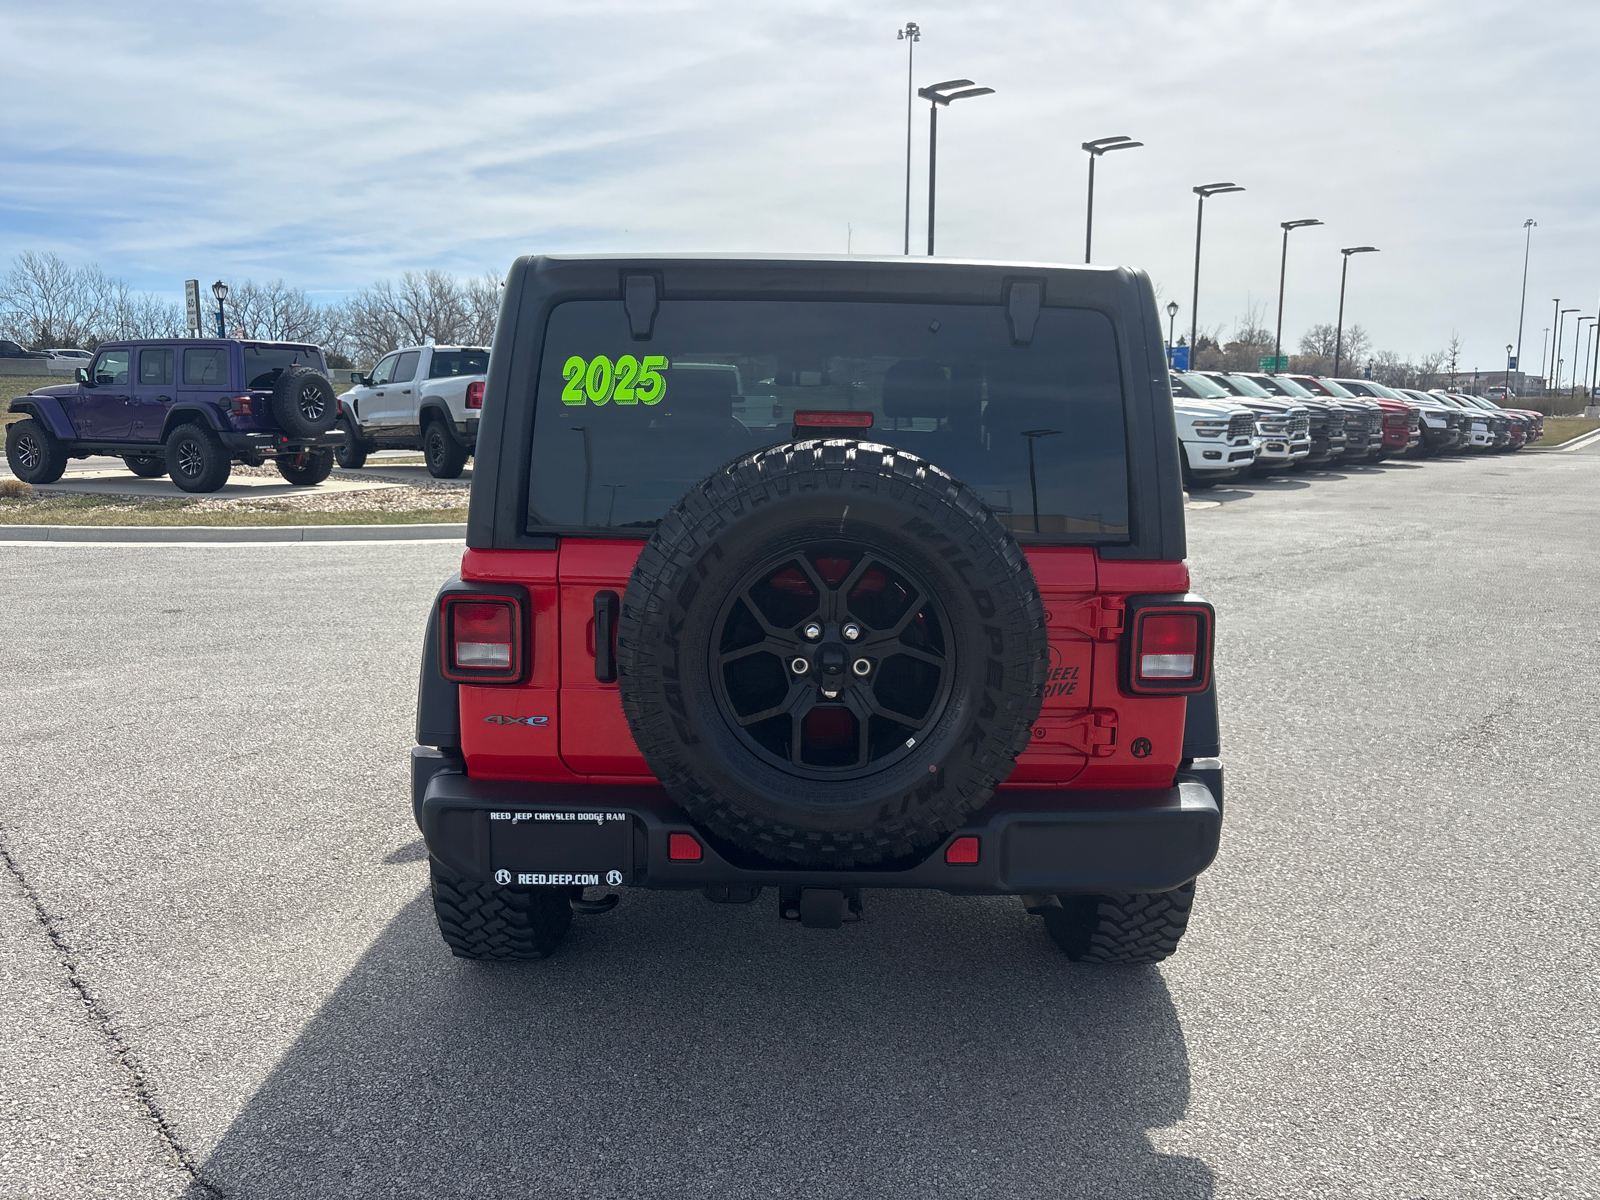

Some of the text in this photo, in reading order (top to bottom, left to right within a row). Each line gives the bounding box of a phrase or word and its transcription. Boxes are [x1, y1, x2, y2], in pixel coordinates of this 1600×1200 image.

[562, 354, 669, 407] 2025
[661, 542, 725, 747] FALKEN
[900, 516, 1004, 754] WILDPEAK
[490, 812, 626, 821] REED JEEP CHRYSLER DODGE RAM
[518, 873, 599, 885] REEDJEEP.COM
